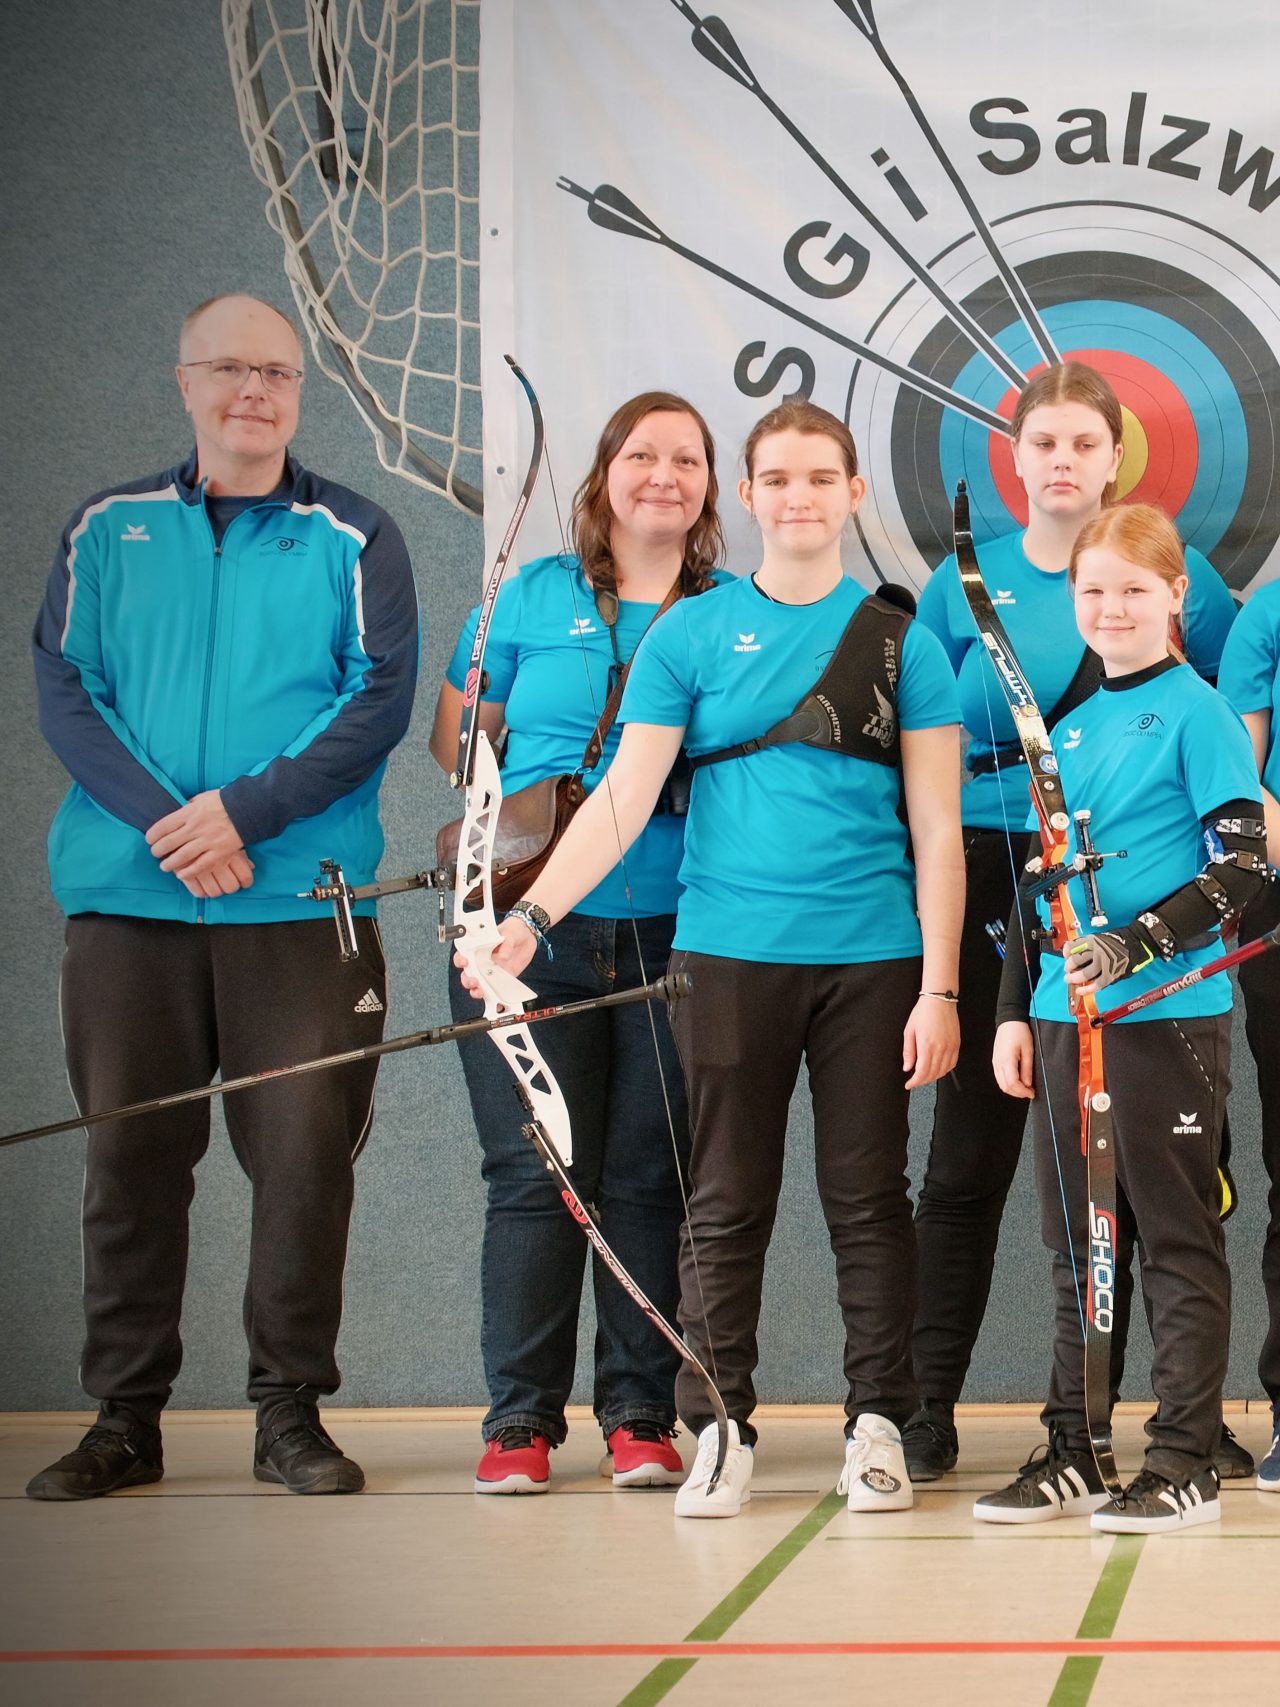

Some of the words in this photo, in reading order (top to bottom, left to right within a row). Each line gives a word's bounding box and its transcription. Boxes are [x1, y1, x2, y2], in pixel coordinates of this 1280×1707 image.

[734, 644, 761, 652] erima
[816, 694, 842, 744] ARCHERY
[354, 1003, 384, 1013] adidas
[1172, 1125, 1202, 1134] erima
